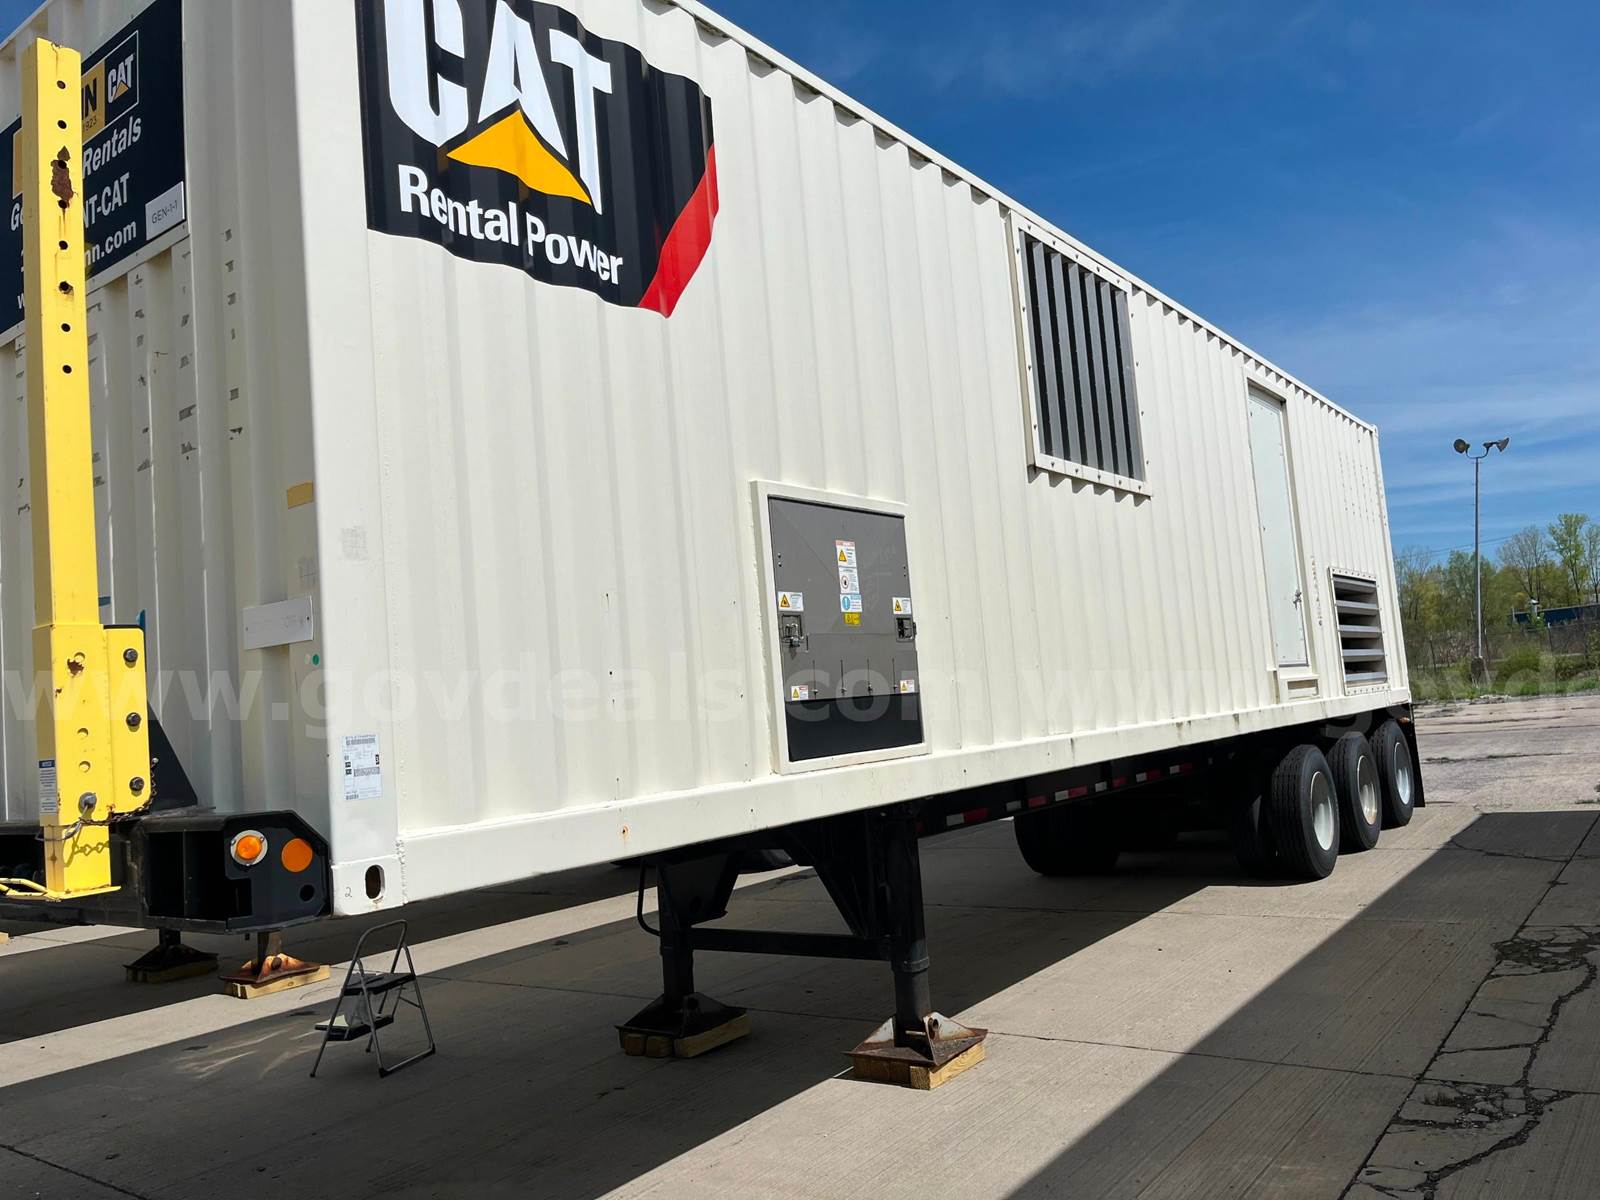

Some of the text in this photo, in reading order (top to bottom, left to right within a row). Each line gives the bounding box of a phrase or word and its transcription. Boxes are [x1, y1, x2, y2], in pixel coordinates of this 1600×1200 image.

[108, 53, 134, 104] CAT
[384, 0, 612, 215] CAT
[82, 116, 142, 179] Rentals
[398, 164, 623, 285] Rental Power
